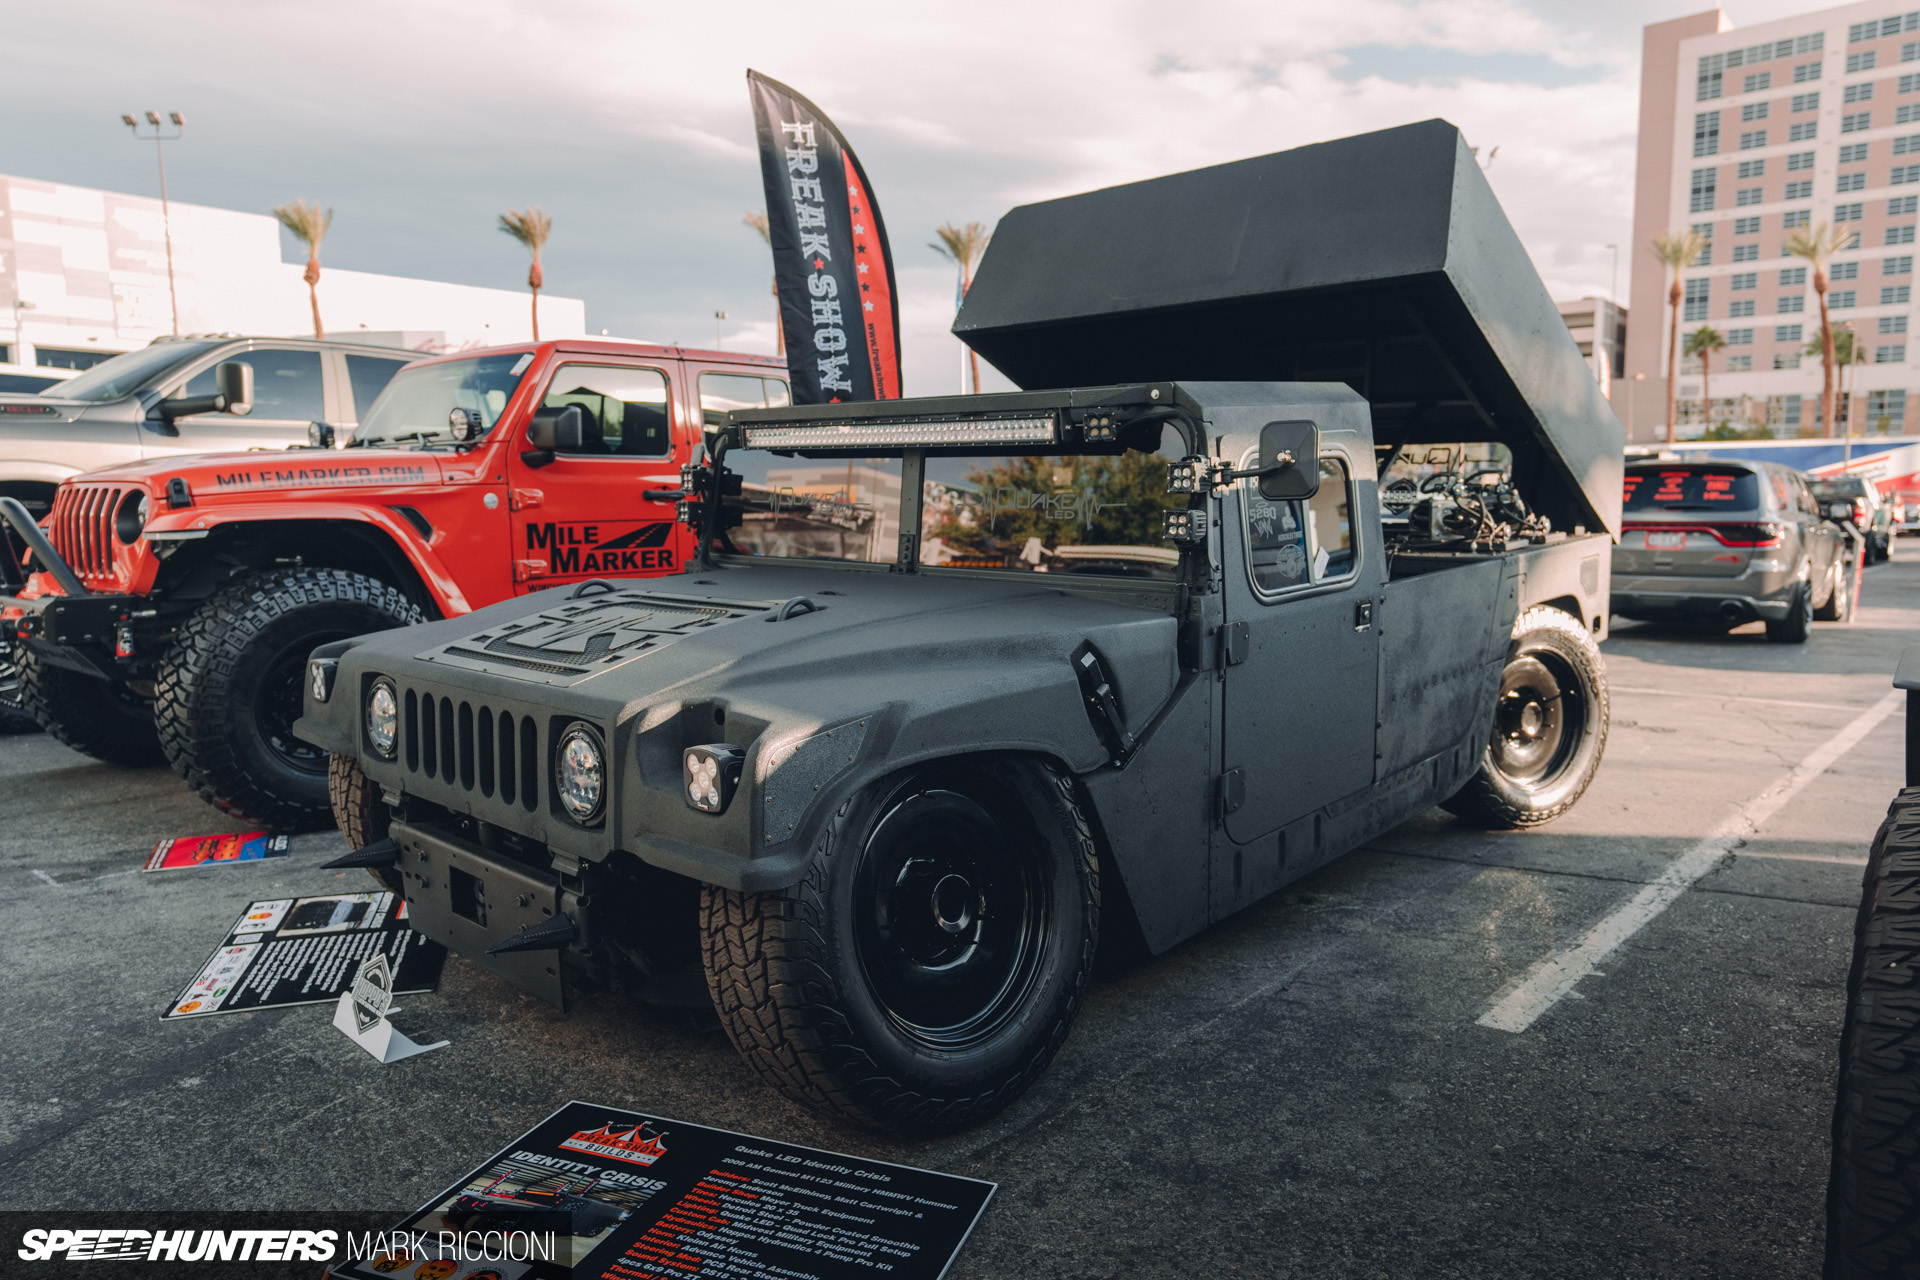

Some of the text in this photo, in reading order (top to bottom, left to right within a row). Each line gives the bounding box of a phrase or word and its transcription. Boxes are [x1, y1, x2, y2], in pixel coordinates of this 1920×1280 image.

[781, 121, 852, 393] FREAK SHOW
[216, 466, 425, 491] MILEMARKER.COM
[996, 487, 1077, 509] QUAKE
[1045, 510, 1076, 519] LED
[1249, 507, 1277, 522] 5280
[526, 522, 599, 549] MILE
[551, 547, 674, 574] MARKER
[575, 1133, 662, 1156] FREAK SHOW
[584, 1143, 634, 1158] BUILDS
[509, 1150, 668, 1191] IDENTITY CRISIS
[735, 1145, 892, 1182] Quake LED Identity Crisis
[702, 1175, 785, 1197] Jeremy Anderson
[709, 1169, 751, 1182] Builders:
[751, 1178, 779, 1188] Scott
[834, 1196, 858, 1205] Matt
[860, 1201, 914, 1216] Cartwright
[721, 1157, 959, 1211] 2009 AM General M1123 Military HMMWV Hummer
[691, 1187, 718, 1198] Tires:
[718, 1194, 762, 1208] Hercules
[764, 1203, 777, 1211] 20
[696, 1181, 875, 1225] Builder Shop: Meyer Truck Equipment
[655, 1220, 739, 1245] Battery: Odyssey
[669, 1207, 872, 1258] Custom Cab: Midwest Military Equipment
[676, 1200, 719, 1214] Lighting:
[720, 1210, 751, 1222] Quake
[752, 1217, 775, 1227] LED
[782, 1225, 811, 1236] Quad
[812, 1231, 837, 1241] Lock
[838, 1236, 856, 1245] Pro
[857, 1241, 879, 1251] Full
[879, 1245, 912, 1258] Setup
[683, 1193, 721, 1206] Wheels:
[721, 1202, 757, 1215] Detroit
[757, 1210, 785, 1221] Steel
[792, 1218, 831, 1231] Powder
[832, 1227, 870, 1240] Coated
[871, 1235, 921, 1251] Smoothie
[647, 1227, 759, 1258] Horn: Kleinn Air Horns
[662, 1213, 718, 1231] Hydraulics:
[718, 1227, 757, 1240] Hoppos
[757, 1236, 813, 1253] Hydraulics
[822, 1251, 853, 1264] Pump
[855, 1258, 874, 1267] Pro
[876, 1263, 894, 1272] Kit
[616, 1257, 643, 1268] 4pcs
[643, 1263, 664, 1273] 6x9
[664, 1268, 683, 1278] Pro
[624, 1249, 657, 1262] Sound
[658, 1257, 700, 1272] System:
[632, 1242, 676, 1257] Steering
[676, 1252, 702, 1263] Mod:
[702, 1258, 726, 1269] PCS
[726, 1264, 753, 1275] Rear
[639, 1234, 820, 1280] Interior: Advance Vehicle Assembly
[609, 1264, 653, 1280] Thermal
